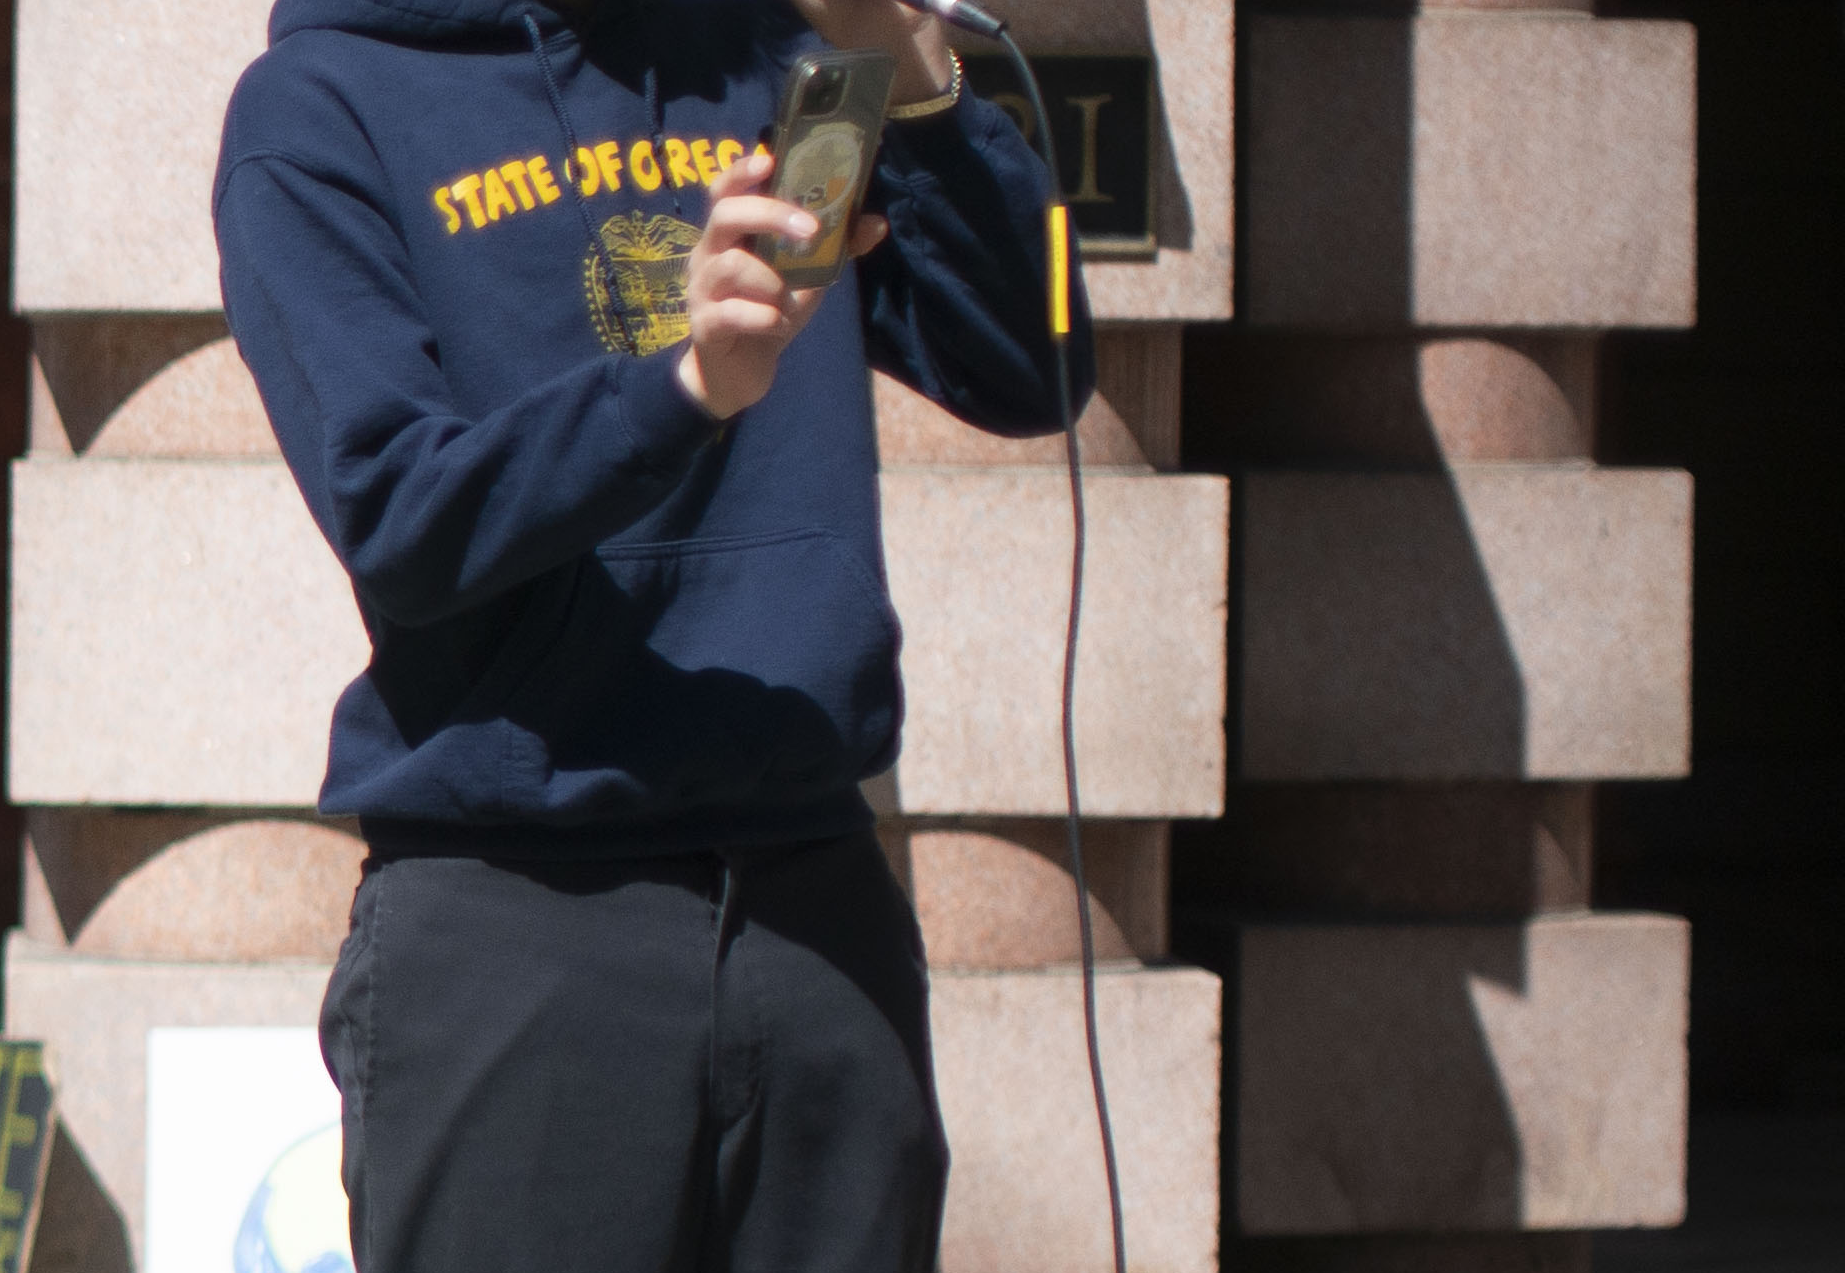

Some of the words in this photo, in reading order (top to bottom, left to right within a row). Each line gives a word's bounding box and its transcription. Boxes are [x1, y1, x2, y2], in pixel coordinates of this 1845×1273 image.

[433, 154, 562, 235] STATE
[564, 140, 624, 197] OF
[629, 137, 771, 194] OREG
